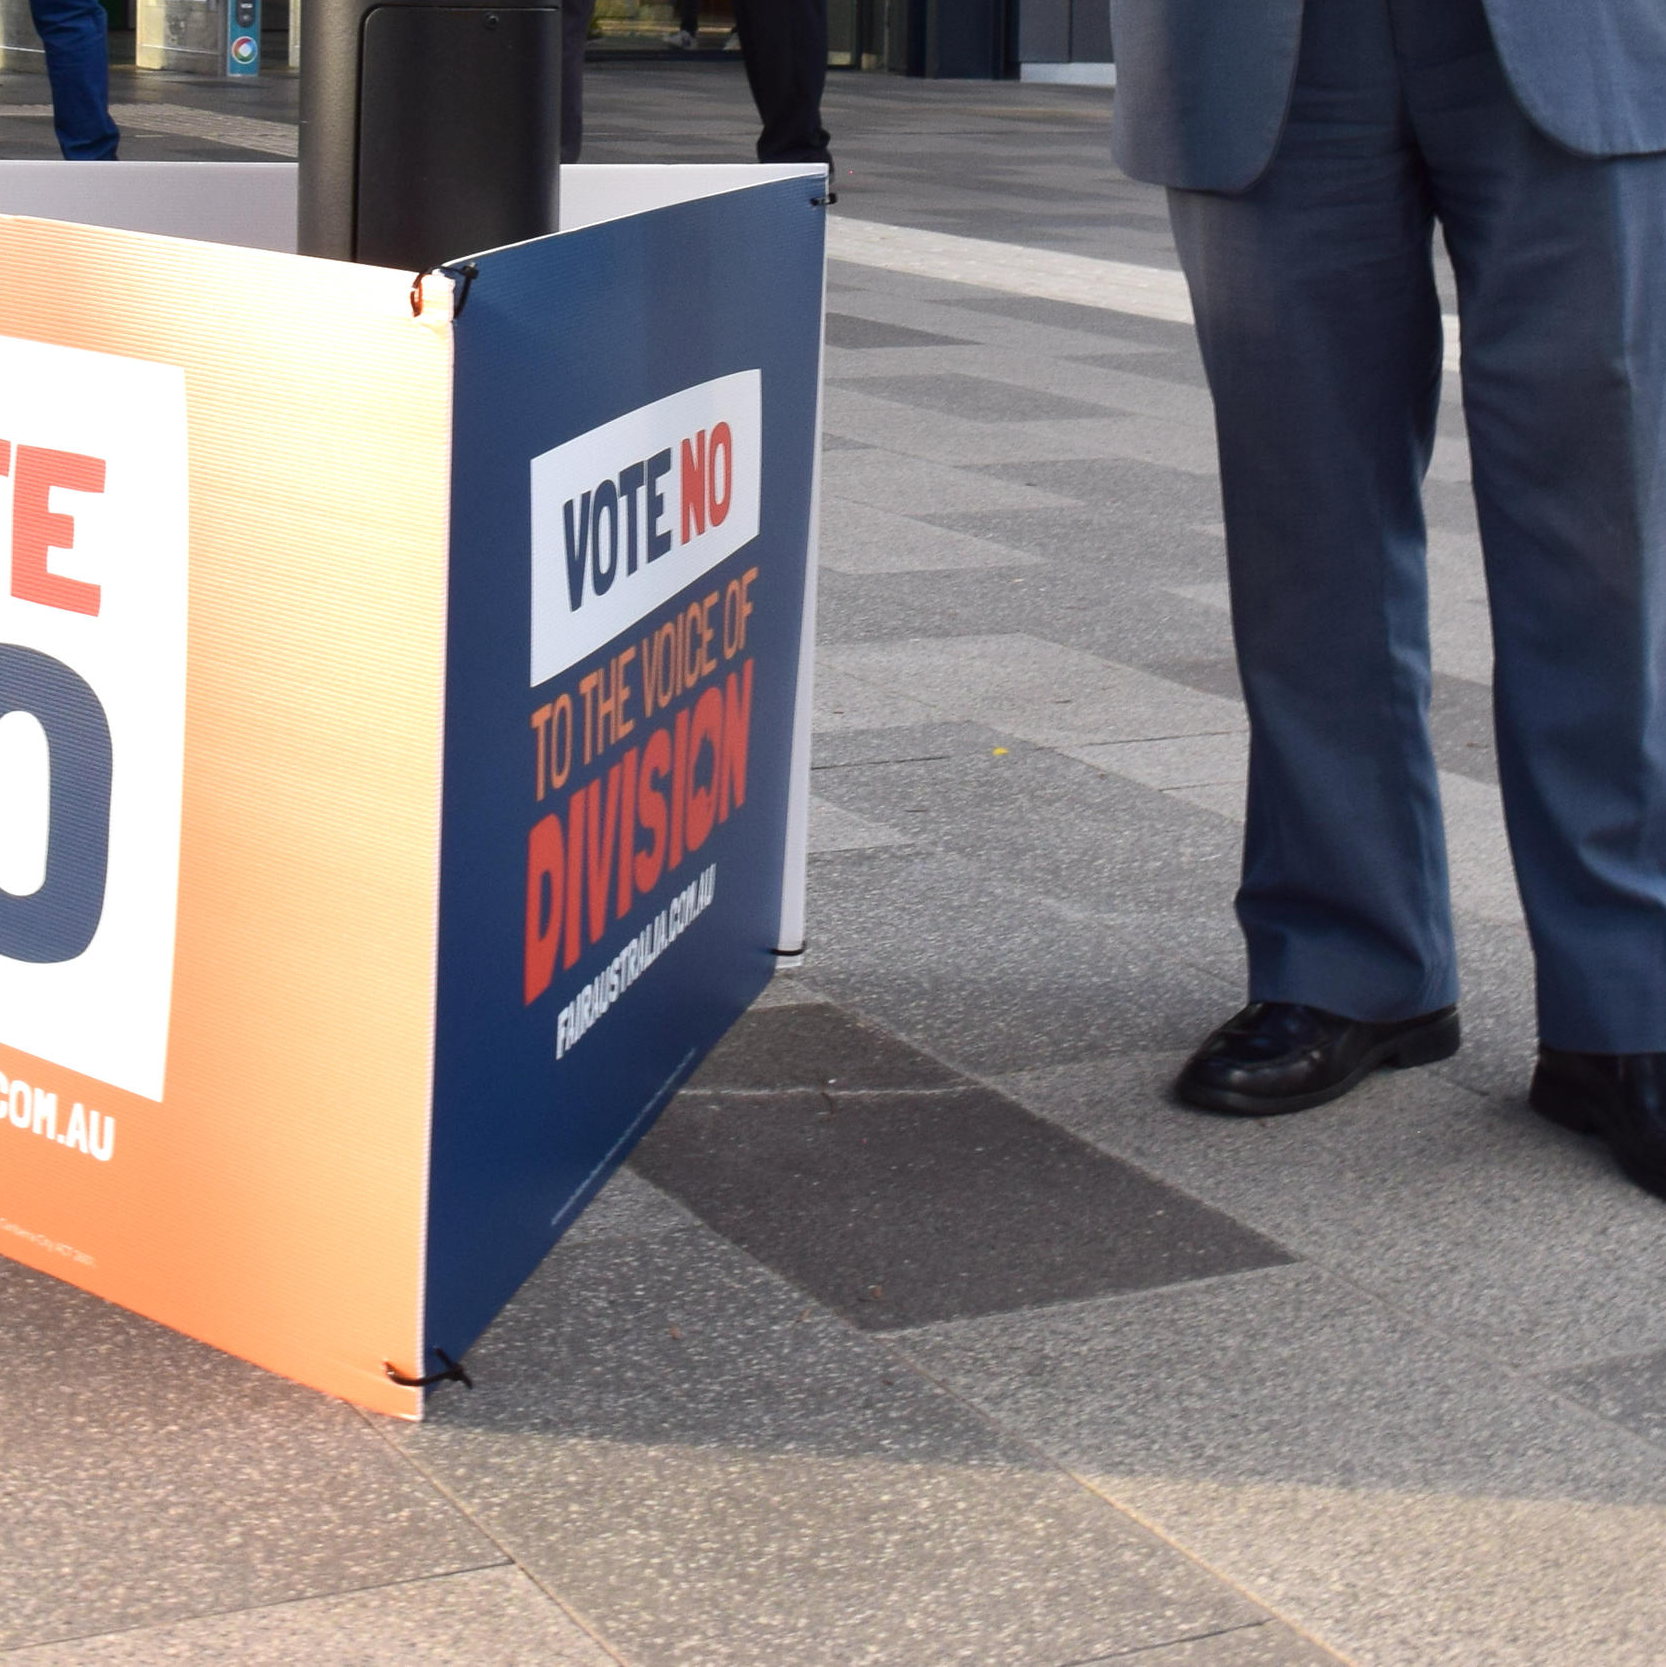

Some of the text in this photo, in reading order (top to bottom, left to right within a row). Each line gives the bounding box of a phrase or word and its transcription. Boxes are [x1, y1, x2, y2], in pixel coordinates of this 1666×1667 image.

[562, 421, 732, 613] VOTE NO
[530, 566, 759, 802] TO THE VOICE OF
[524, 657, 755, 1008] DIVISION
[555, 863, 718, 1061] FAIRAUSTRALIA.COM.AU
